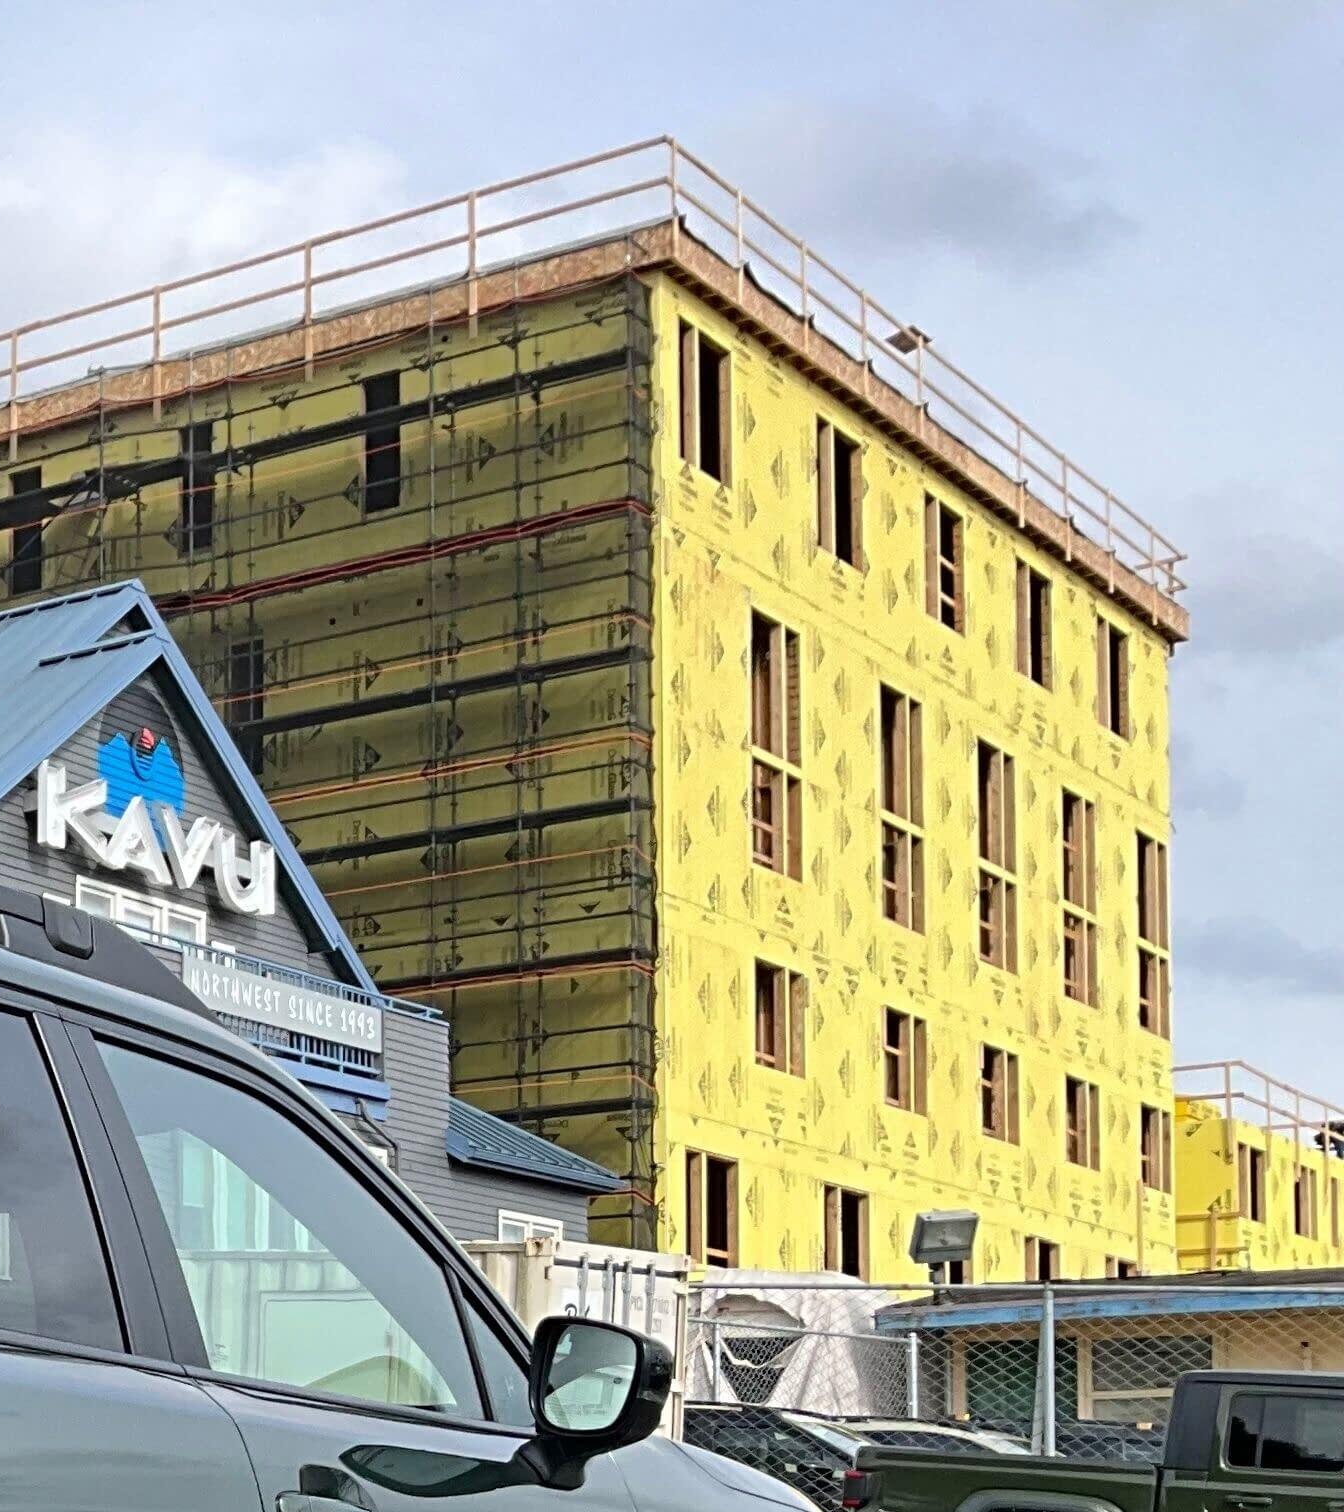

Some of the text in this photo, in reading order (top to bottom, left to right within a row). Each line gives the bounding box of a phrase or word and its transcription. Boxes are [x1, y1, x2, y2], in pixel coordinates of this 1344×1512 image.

[37, 759, 275, 915] KAVU
[190, 968, 376, 1040] NORTHWEST SINCE 1993
